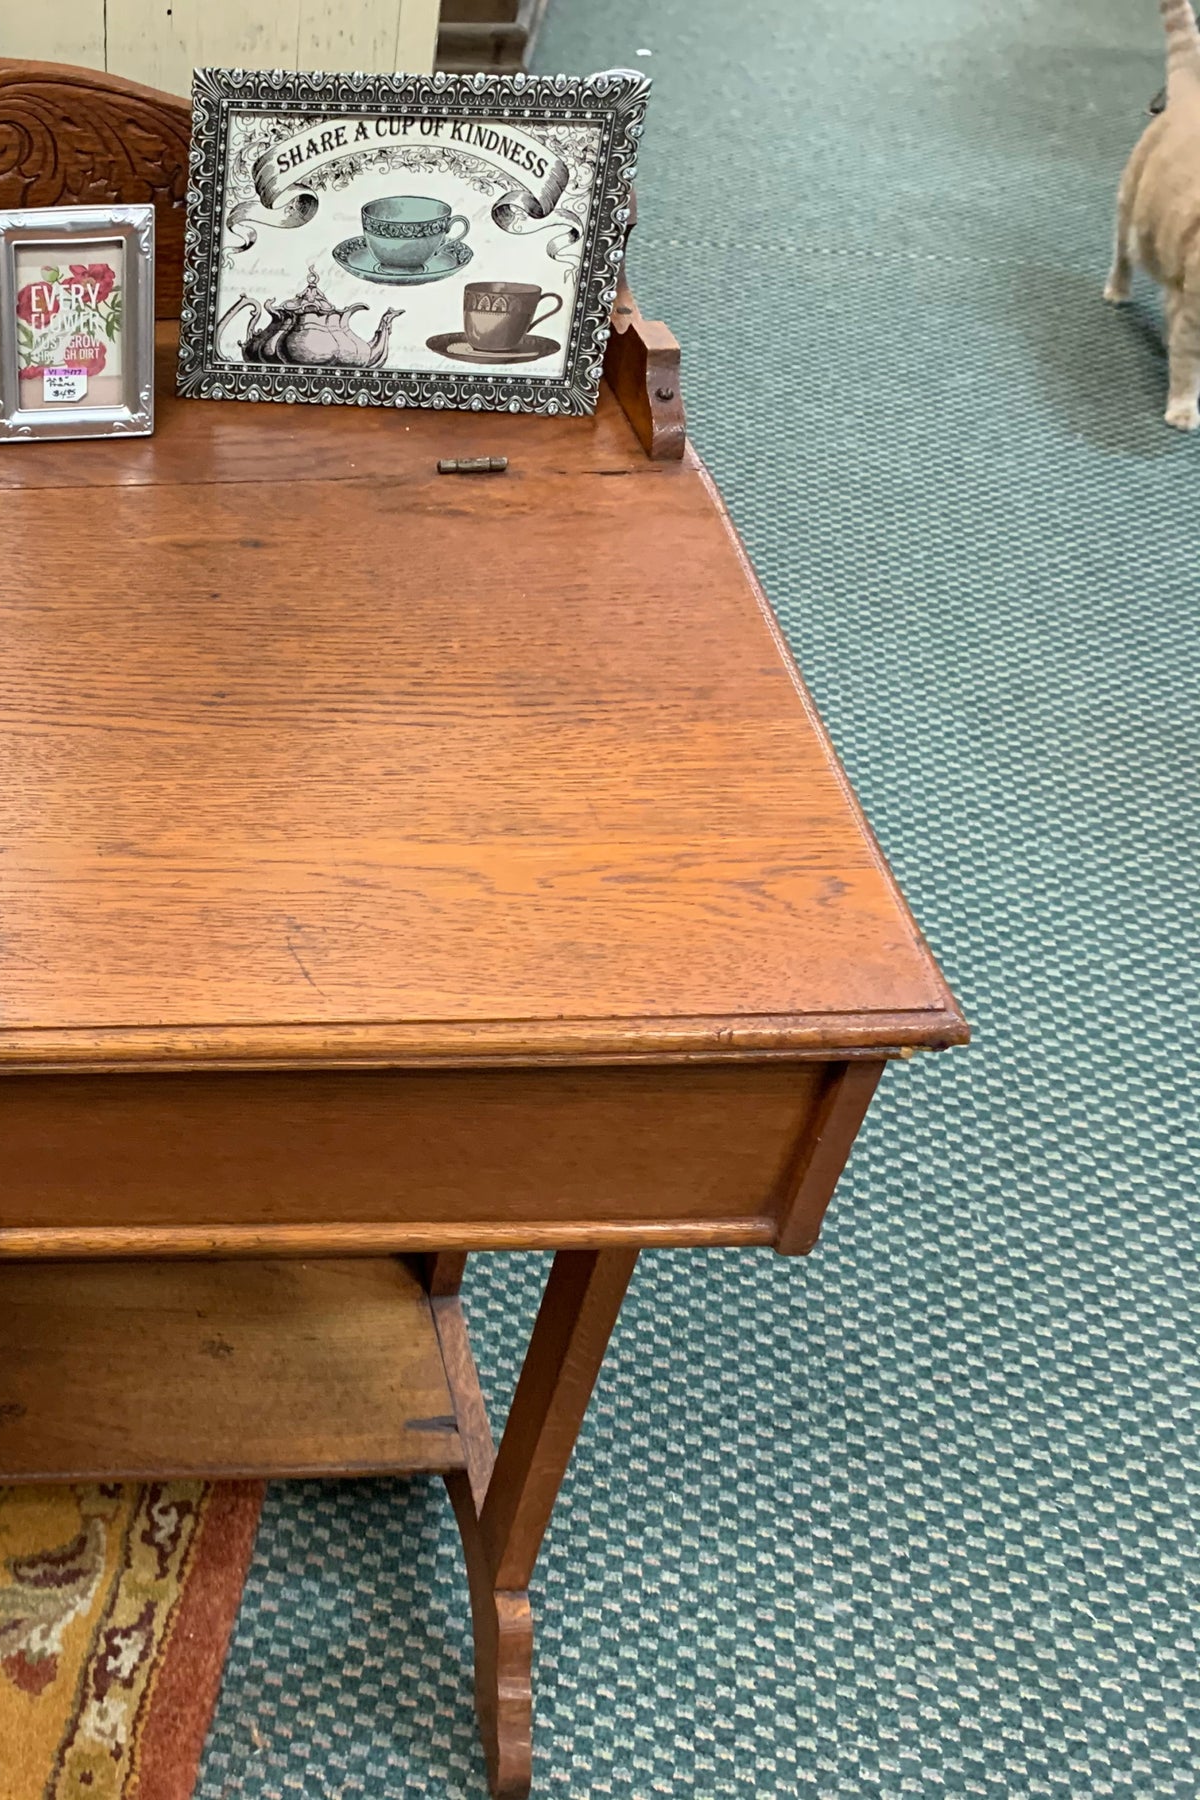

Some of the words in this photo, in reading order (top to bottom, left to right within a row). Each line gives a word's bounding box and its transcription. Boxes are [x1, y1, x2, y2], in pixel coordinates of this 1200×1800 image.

[277, 125, 348, 175] SHARE
[354, 121, 371, 142] A
[375, 117, 415, 137] CUP
[420, 117, 448, 137] OF
[450, 123, 549, 180] KINDNESS
[31, 283, 100, 312] EVERY
[31, 311, 101, 333] FLOWER
[68, 335, 101, 349] GROW
[79, 348, 101, 360] DIRT
